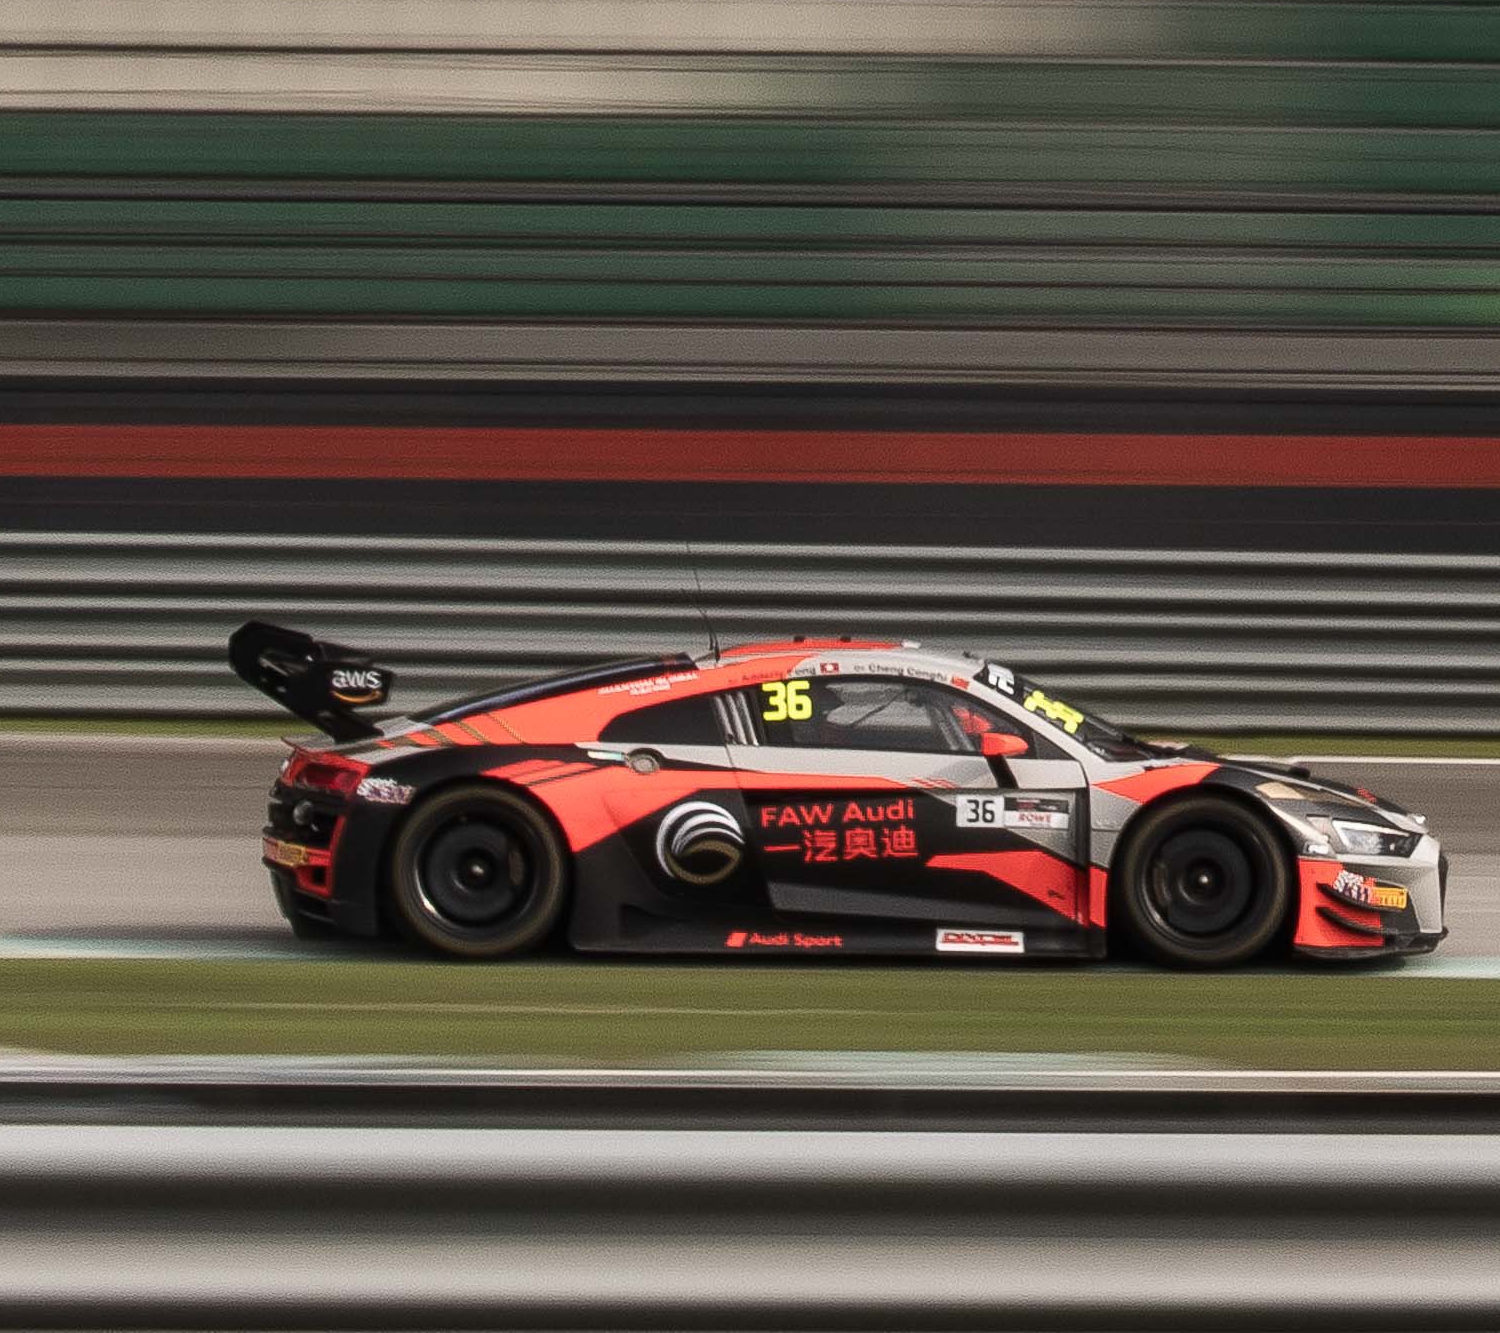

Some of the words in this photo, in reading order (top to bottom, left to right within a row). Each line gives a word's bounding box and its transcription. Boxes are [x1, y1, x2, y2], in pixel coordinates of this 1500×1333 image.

[332, 670, 382, 689] aws
[762, 680, 812, 721] 36
[761, 803, 834, 828] FAW
[843, 798, 916, 823] Audi
[966, 799, 995, 823] 36
[764, 824, 919, 863] 一汽奥迪
[750, 933, 789, 946] Audi
[794, 933, 843, 948] Sport
